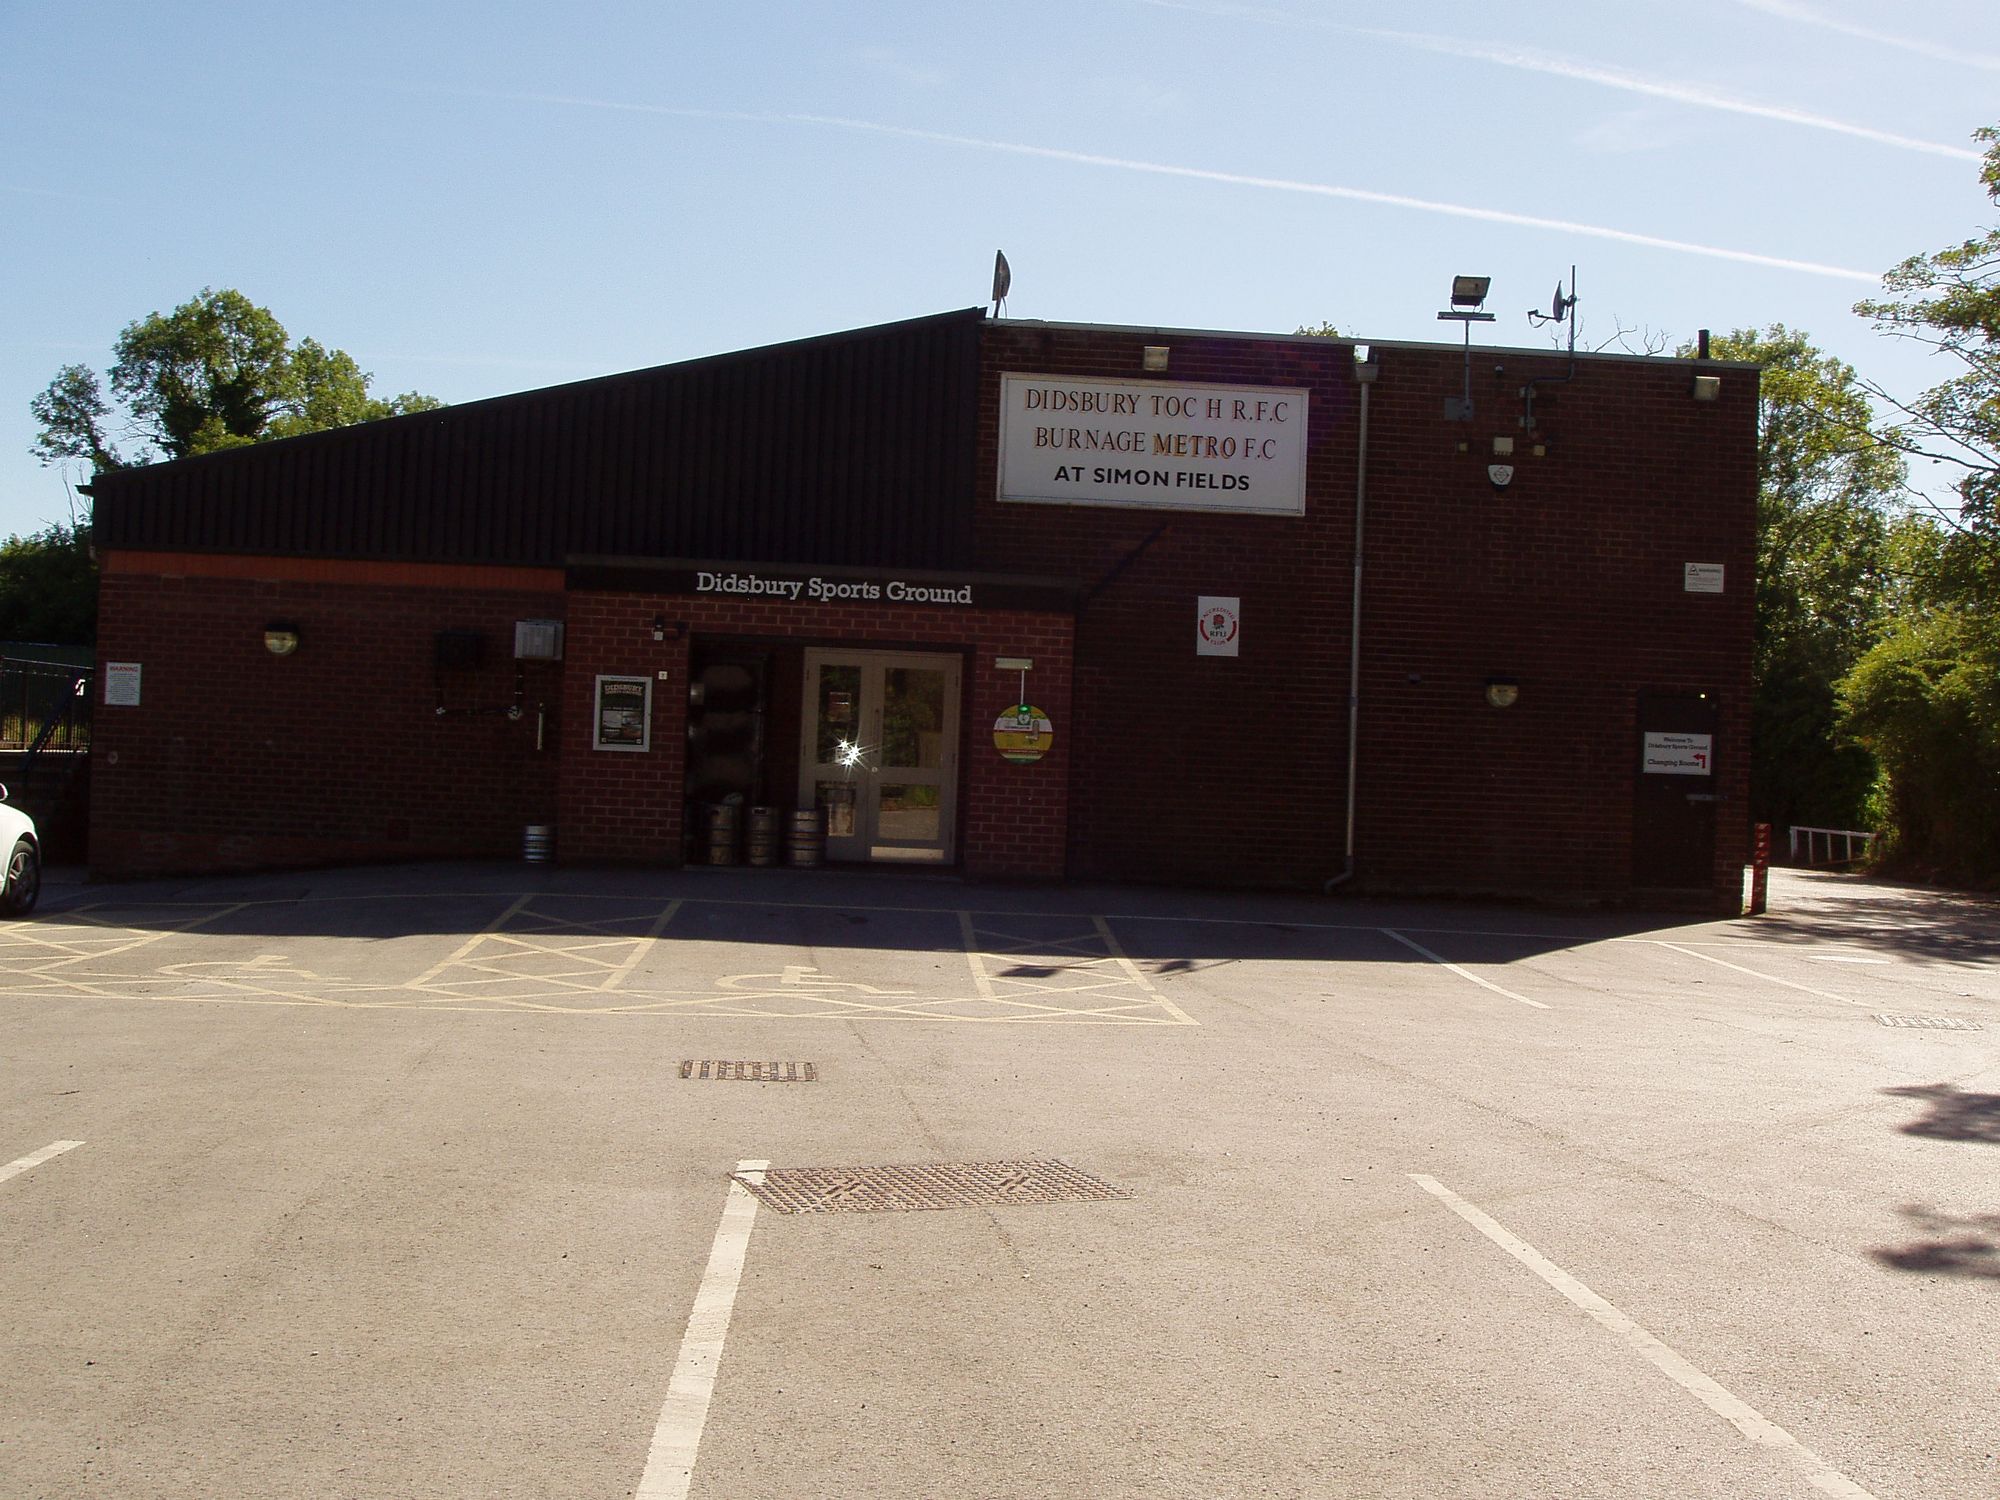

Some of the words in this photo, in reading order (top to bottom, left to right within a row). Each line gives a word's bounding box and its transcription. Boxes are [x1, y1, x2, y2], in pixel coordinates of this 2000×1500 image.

[1025, 388, 1141, 415] DIDSBURY
[1151, 395, 1197, 418] TOC
[1207, 398, 1222, 419] H
[1232, 399, 1289, 423] R.F.C
[1034, 427, 1146, 453] BURNAGE
[1152, 432, 1237, 459] METRO
[1244, 437, 1277, 460] F.C
[1054, 466, 1086, 482] AT
[1093, 467, 1169, 487] SIMON
[1176, 471, 1251, 491] FIELDS
[696, 572, 803, 600] Didsbury
[808, 577, 880, 602] Sports
[886, 581, 973, 604] Ground
